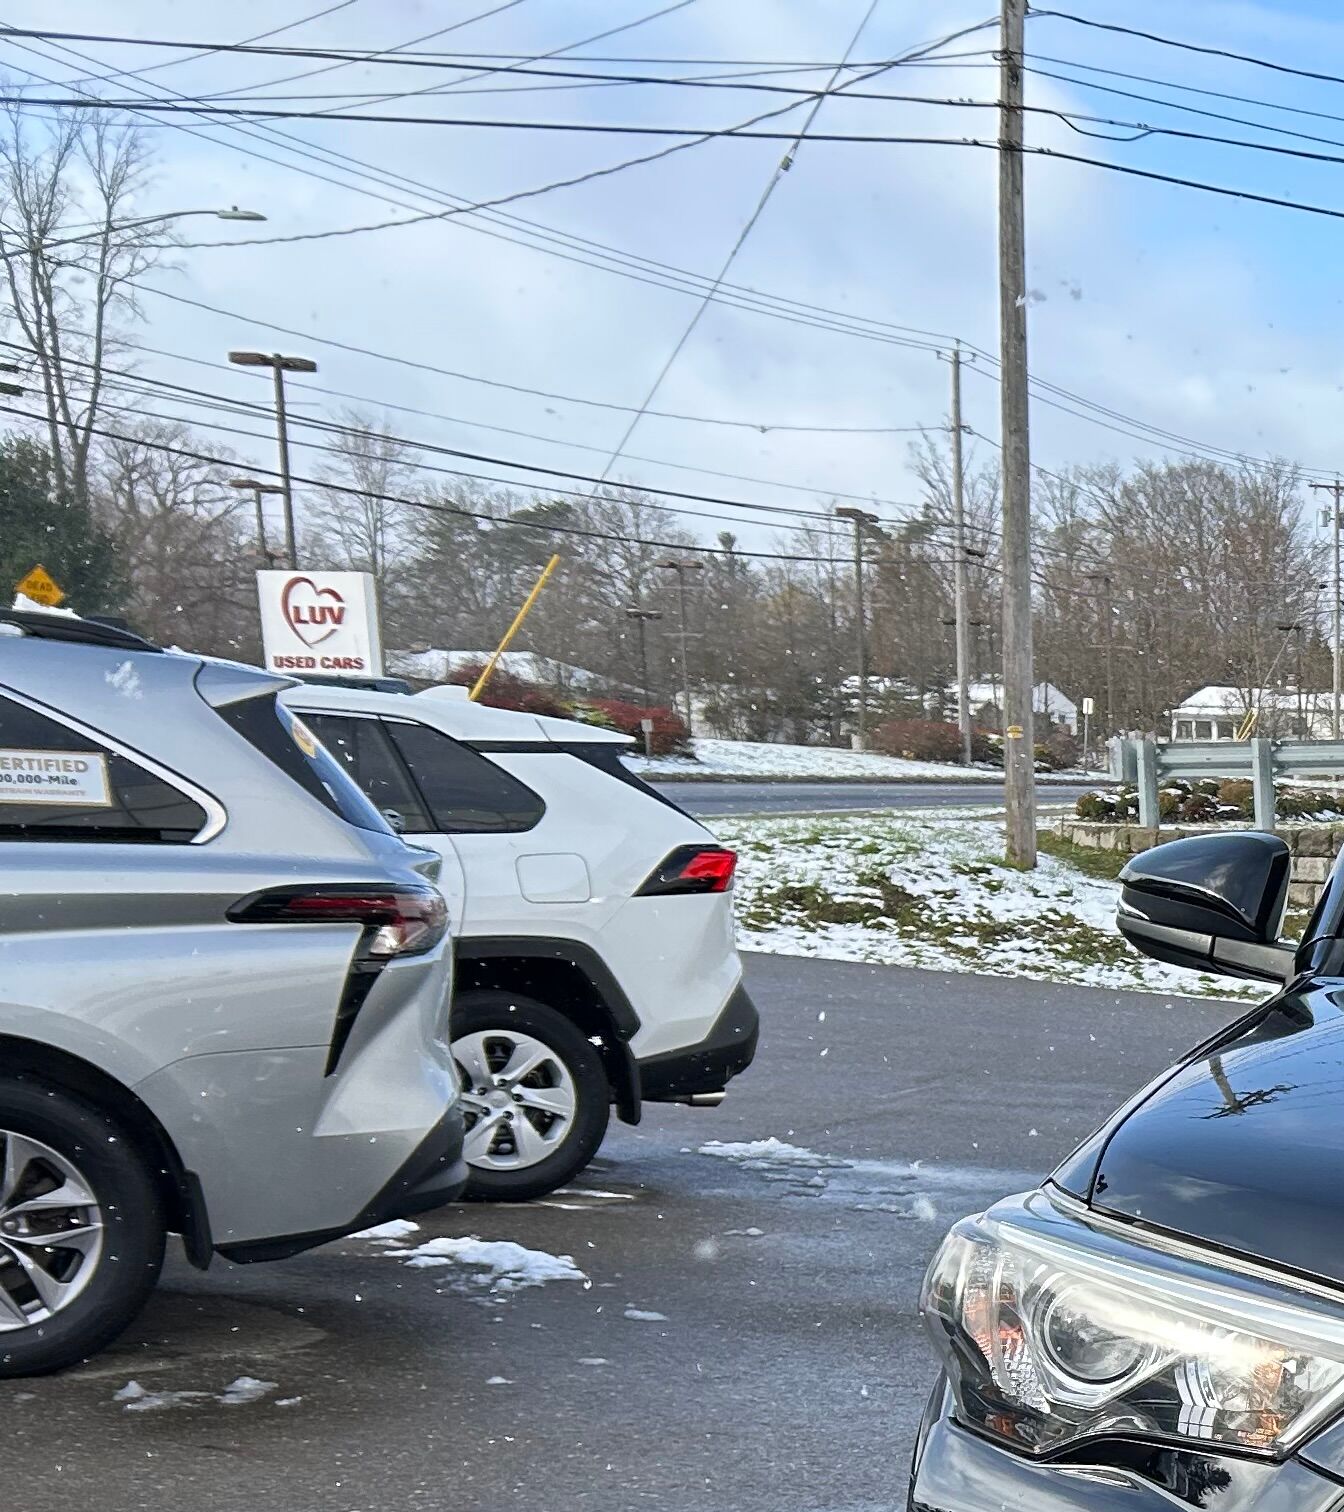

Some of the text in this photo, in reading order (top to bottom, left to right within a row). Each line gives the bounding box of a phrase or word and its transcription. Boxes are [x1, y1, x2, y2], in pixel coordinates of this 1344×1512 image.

[292, 605, 345, 625] LUV
[273, 655, 365, 670] USED CARS
